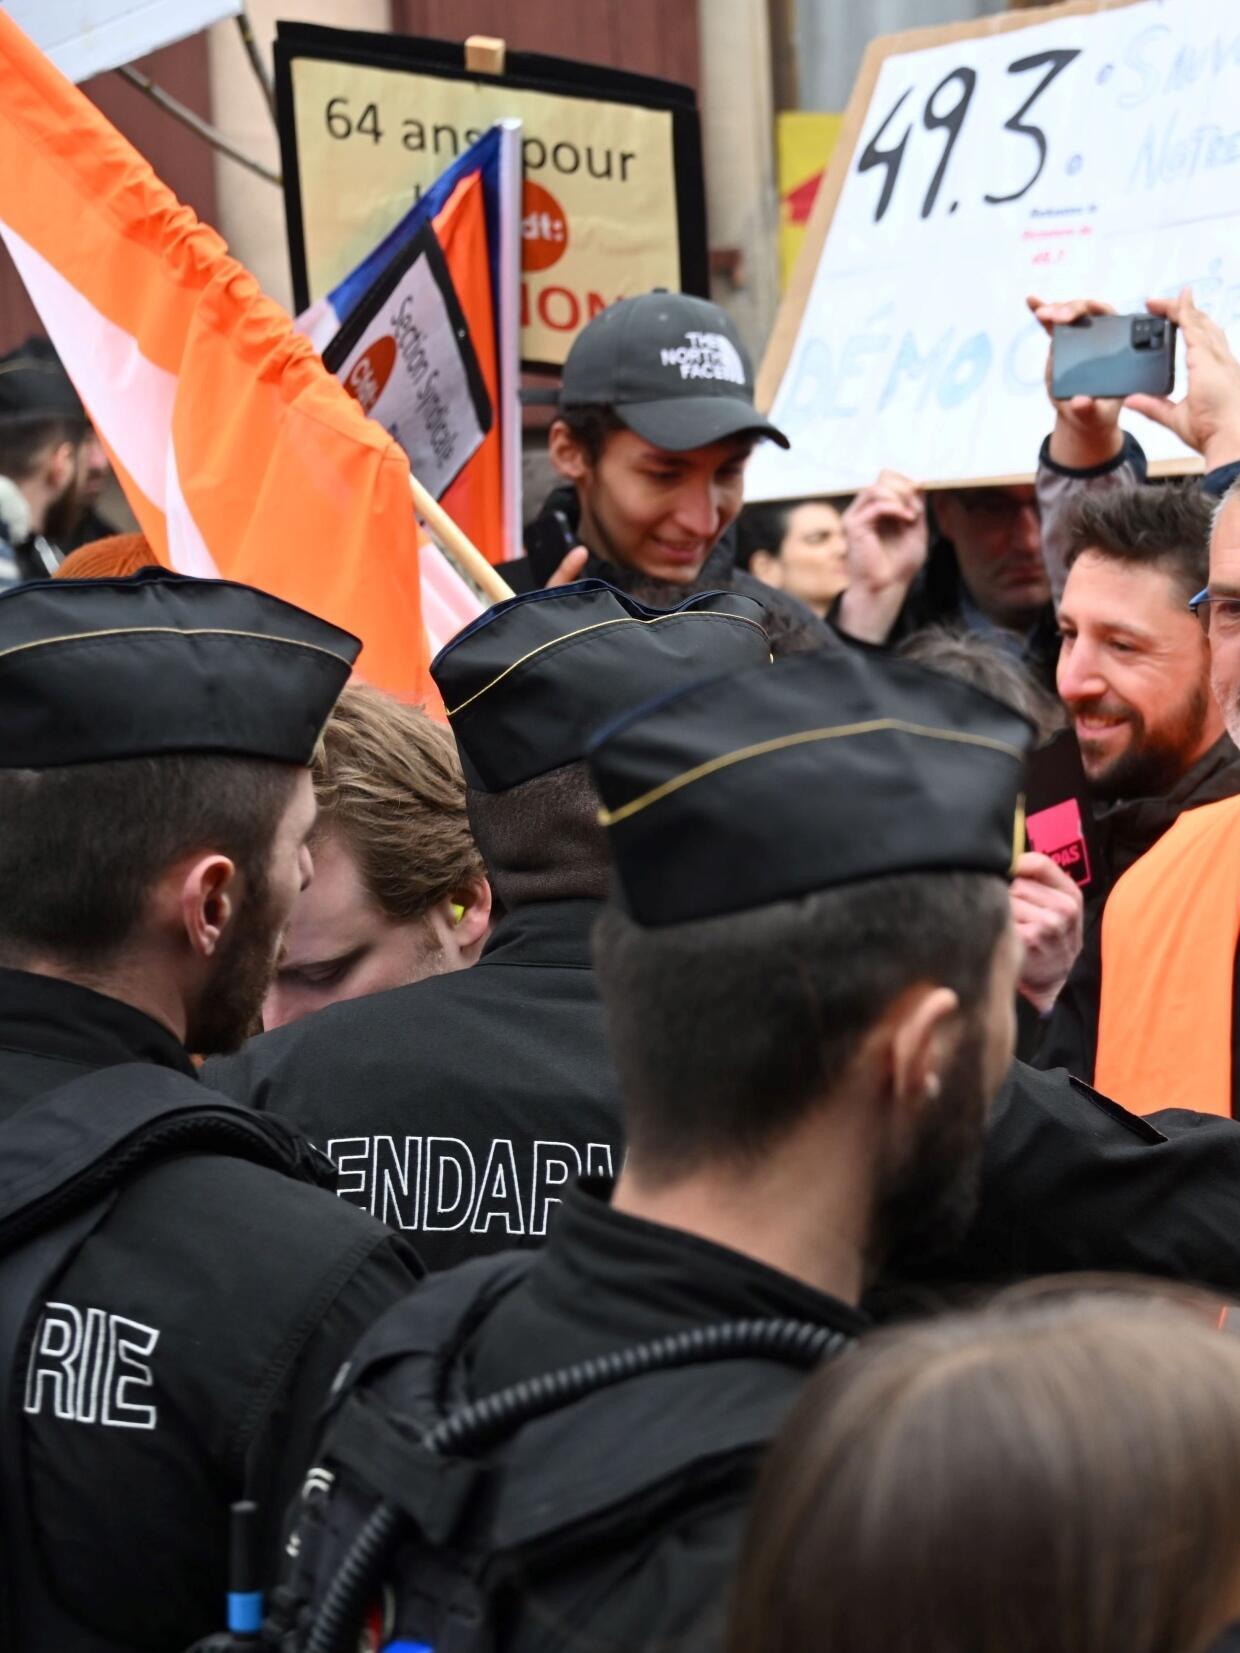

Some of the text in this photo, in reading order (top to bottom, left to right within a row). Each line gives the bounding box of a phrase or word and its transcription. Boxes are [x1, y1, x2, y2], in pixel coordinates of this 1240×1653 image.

[324, 96, 383, 146] 64
[522, 136, 636, 183] pour
[660, 346, 724, 367] NORTH
[684, 331, 720, 351] THE
[326, 1135, 614, 1235] ENDAR
